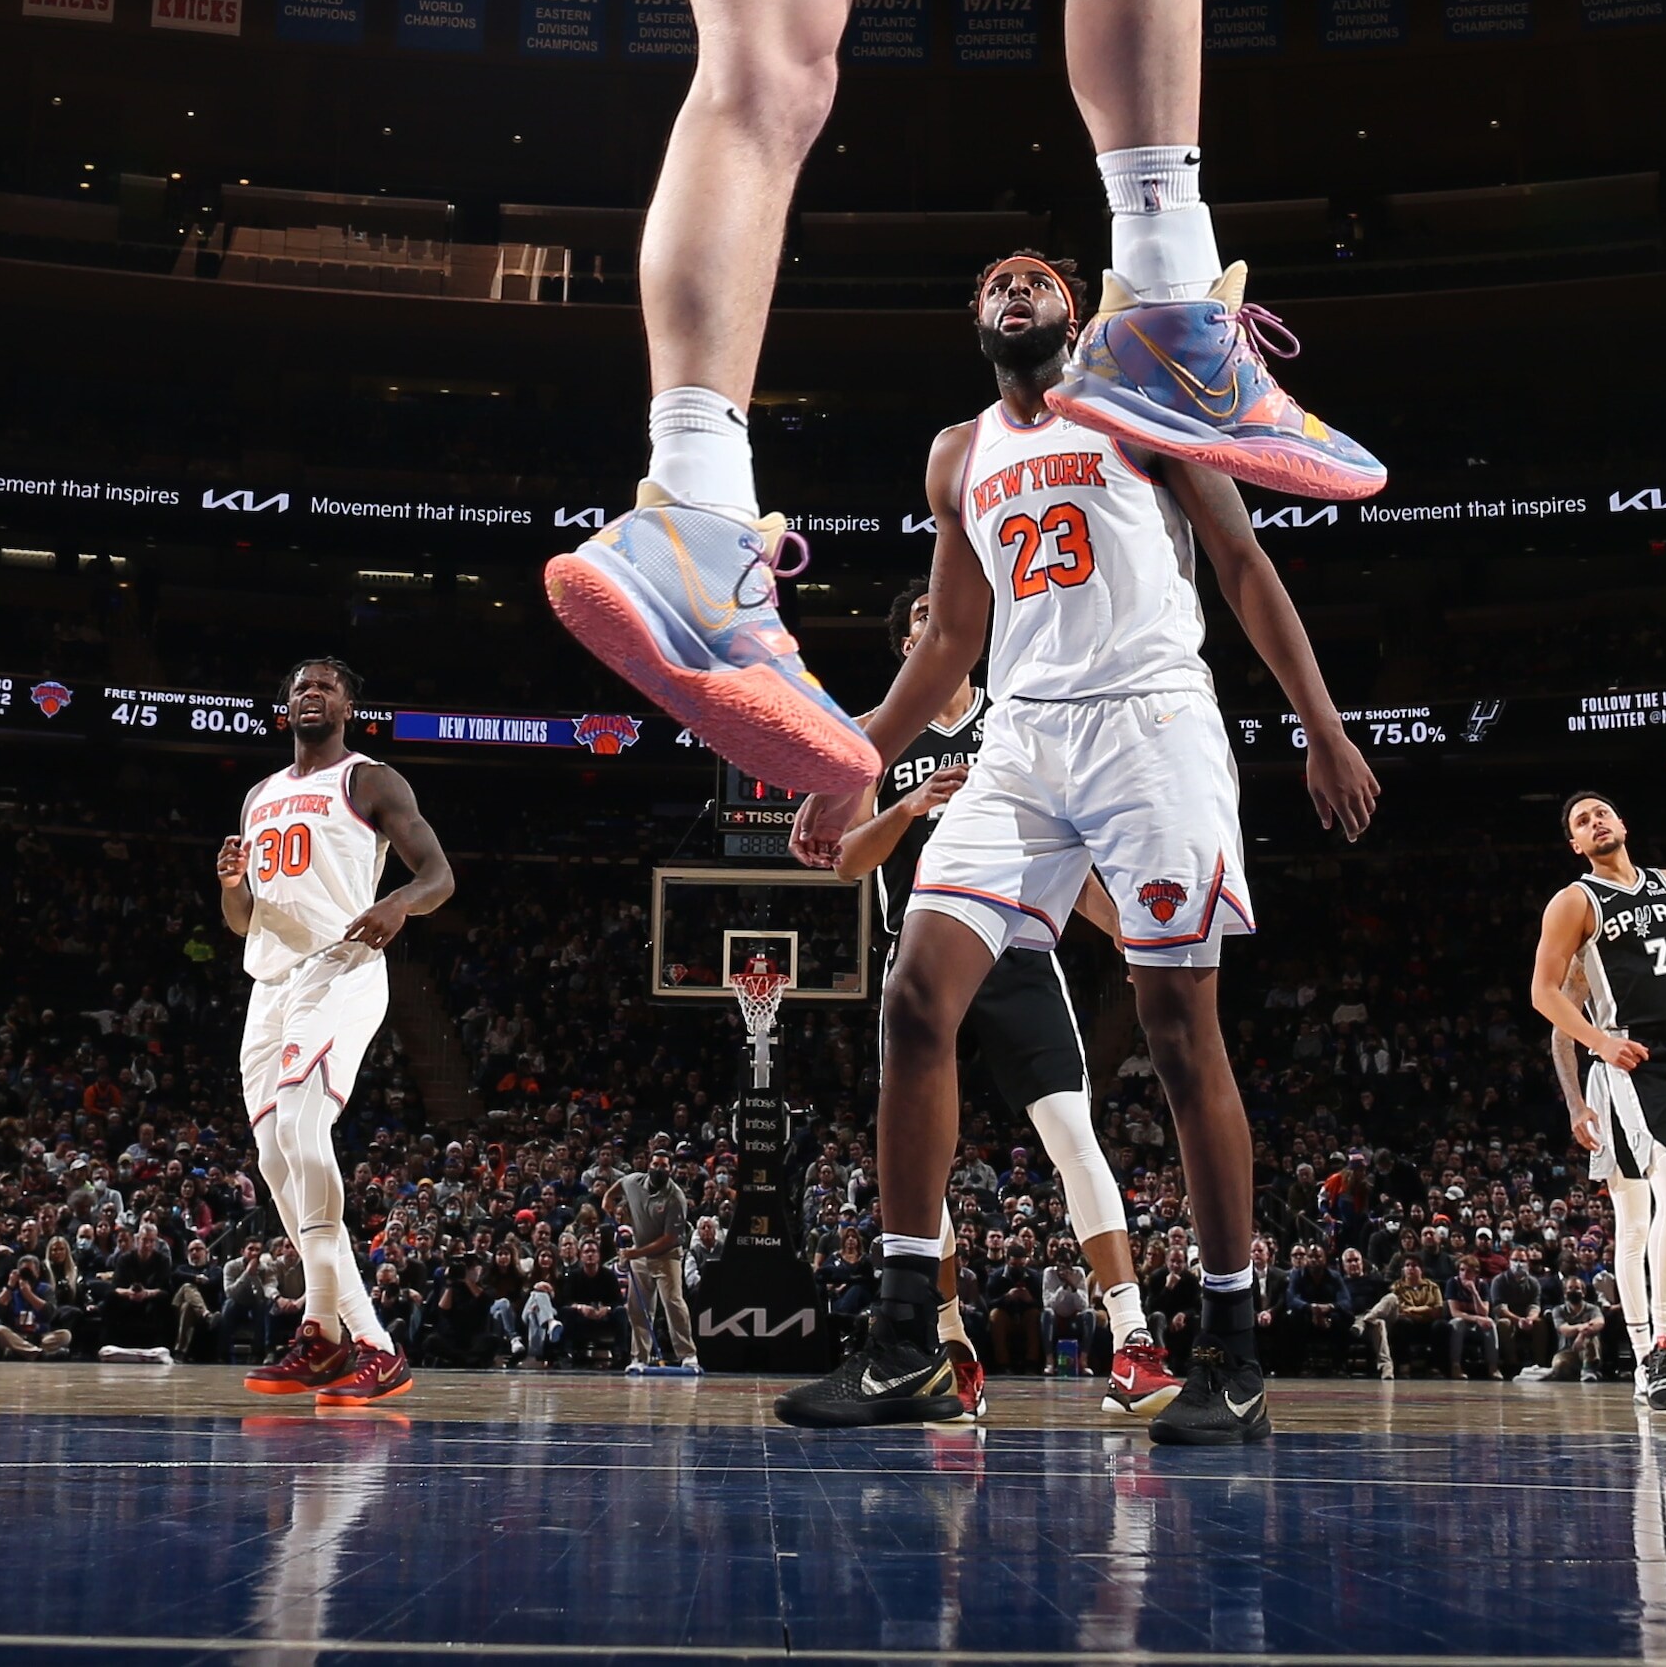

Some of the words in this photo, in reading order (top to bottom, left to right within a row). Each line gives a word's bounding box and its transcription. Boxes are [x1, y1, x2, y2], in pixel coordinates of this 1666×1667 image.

[283, 4, 357, 23] CHAMPIONS
[535, 7, 592, 22] EASTERN
[1209, 6, 1269, 19] ATLANTIC
[1446, 3, 1529, 18] CONFERENCE
[1588, 3, 1663, 22] CHAMPIONS
[404, 12, 477, 30] CHAMPIONS
[859, 15, 916, 29] ATLANTIC
[968, 17, 1024, 30] EASTERN
[1213, 21, 1265, 34] DIVISION
[1336, 13, 1388, 26] DIVISION
[1452, 19, 1525, 34] CHAMPIONS
[537, 21, 589, 37] DIVISION
[639, 26, 691, 39] DIVISION
[1326, 26, 1400, 42] CHAMPIONS
[526, 37, 599, 53] CHAMPIONS
[862, 31, 913, 44] DIVISION
[955, 32, 1037, 45] CONFERENCE
[1204, 35, 1276, 49] CHAMPIONS
[851, 46, 924, 60] CHAMPIONS
[960, 47, 1032, 61] CHAMPIONS
[61, 477, 101, 499] that
[105, 480, 180, 506] inspires
[973, 460, 1024, 518] NEW
[1027, 452, 1108, 491] YORK
[311, 497, 412, 519] Movement
[416, 501, 455, 521] that
[460, 503, 532, 526] inspires
[1360, 500, 1462, 523] Movement
[1468, 496, 1507, 517] that
[1512, 494, 1586, 517] inspires
[808, 511, 880, 535] inspires
[998, 501, 1096, 602] 23
[104, 688, 137, 701] FREE
[140, 690, 185, 704] THROW
[189, 694, 254, 709] SHOOTING
[1582, 694, 1631, 712] FOLLOW
[1636, 692, 1658, 708] THE
[112, 703, 158, 728] 4/5
[1365, 707, 1431, 720] SHOOTING
[1568, 715, 1586, 732] ON
[1589, 710, 1646, 731] TWITTER
[190, 709, 267, 736] 80.0%
[438, 717, 464, 739] NEW
[468, 718, 500, 741] YORK
[503, 720, 548, 743] KNICKS
[1238, 719, 1262, 729] TOL
[1369, 721, 1446, 745] 75.0%
[250, 798, 284, 827] NEW
[286, 794, 333, 817] YORK
[256, 822, 311, 883] 30
[745, 1098, 777, 1109] Infosys
[745, 1118, 777, 1131] Infosys
[745, 1140, 777, 1152] Infosys
[737, 1237, 781, 1246] BETMGM
